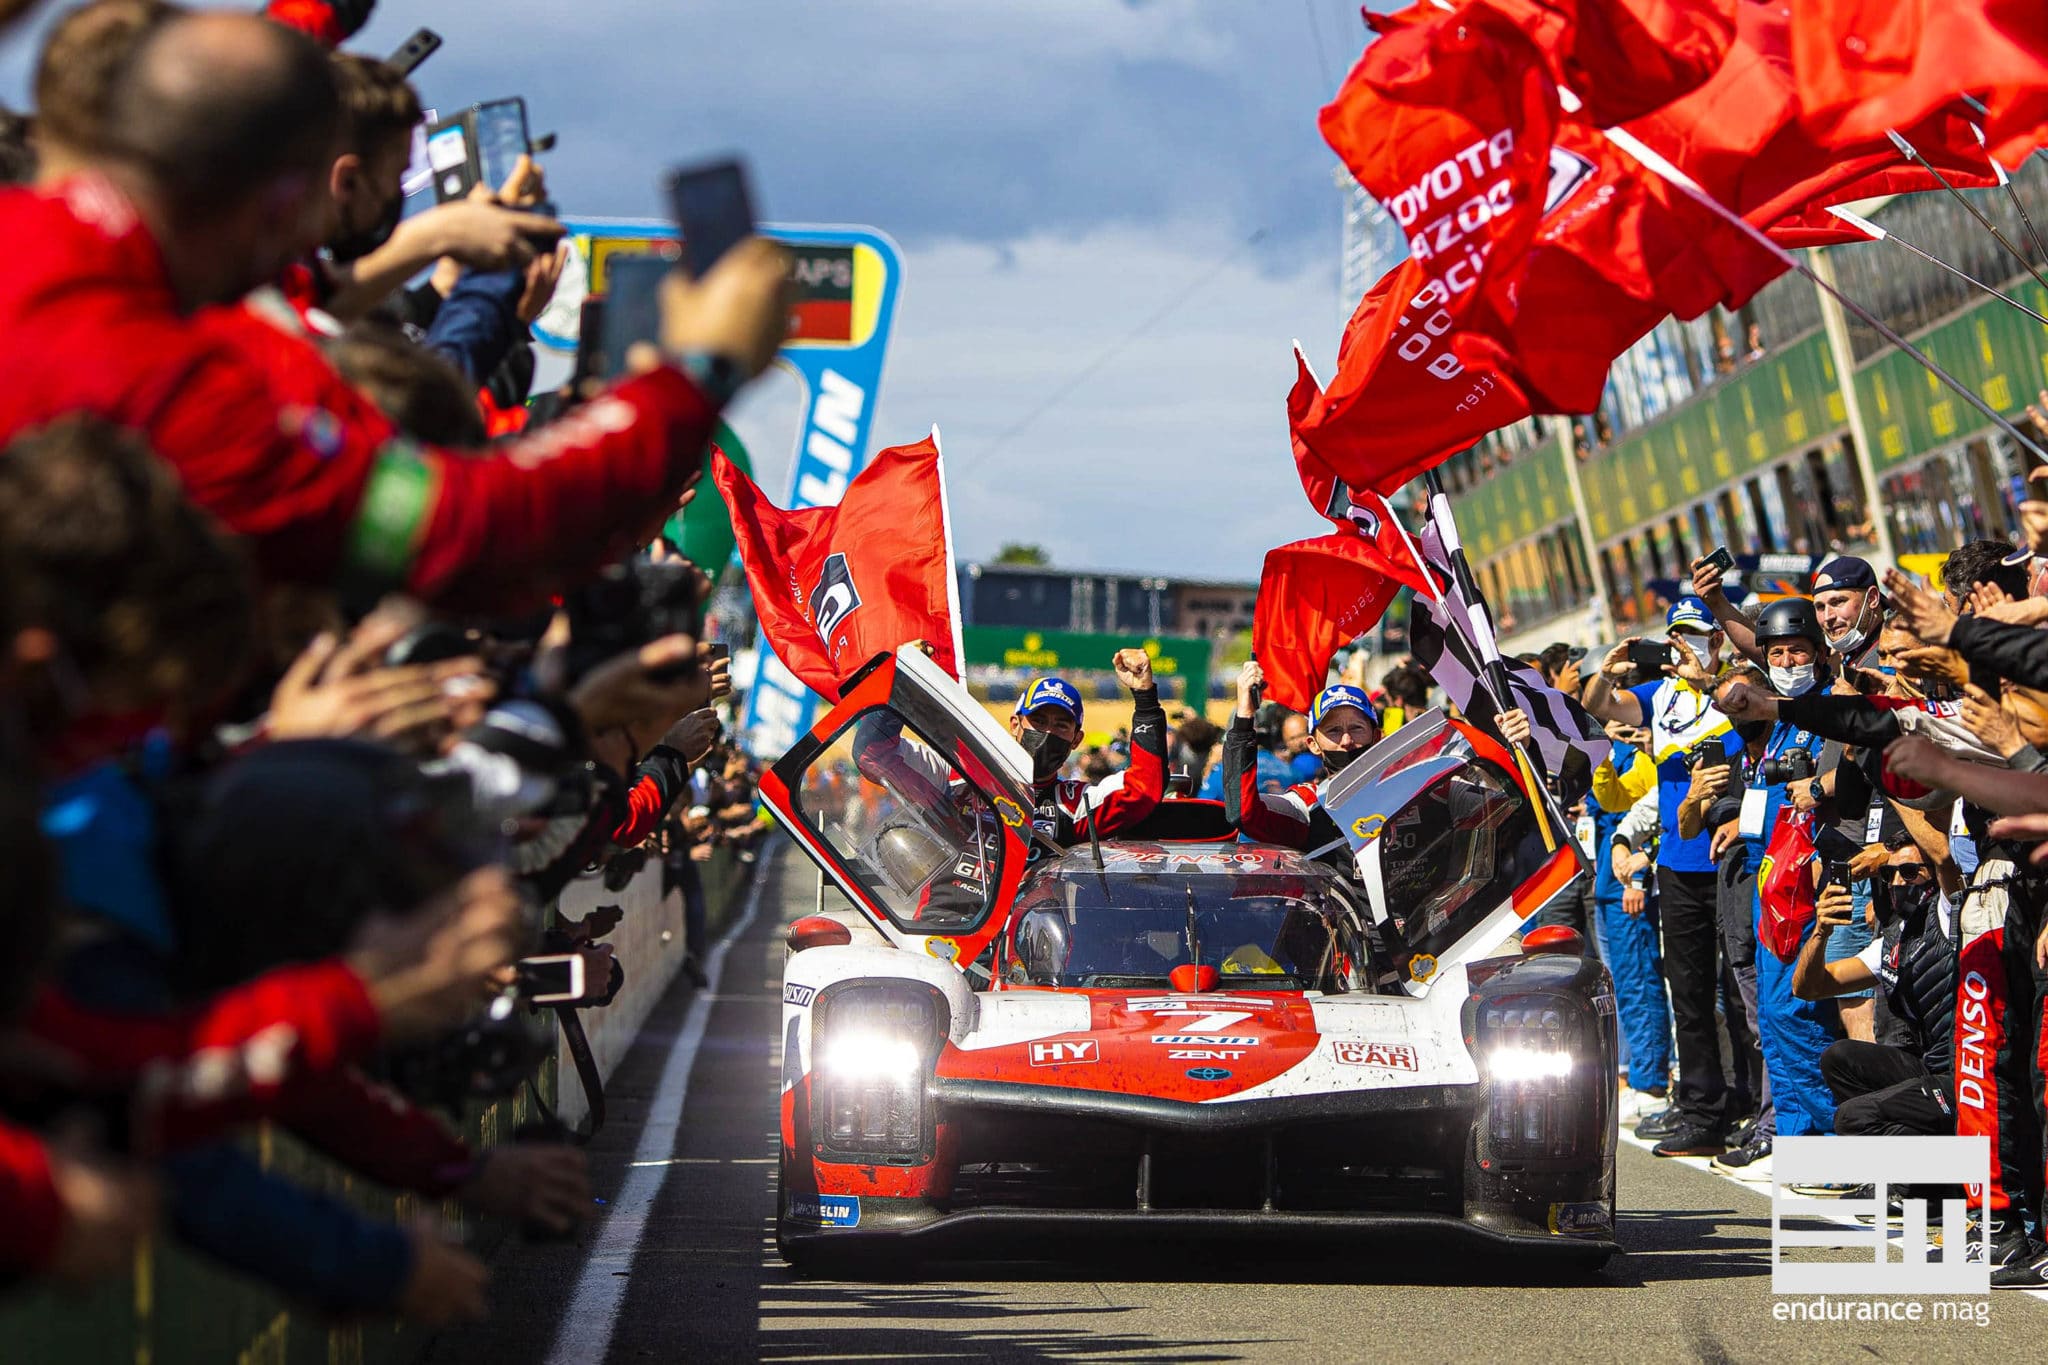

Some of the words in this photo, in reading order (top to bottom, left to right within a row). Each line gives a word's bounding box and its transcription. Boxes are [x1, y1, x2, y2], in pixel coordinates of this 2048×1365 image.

[1382, 129, 1514, 227] OYOTA
[1410, 179, 1514, 259] AZOO
[794, 257, 852, 288] APS
[952, 880, 986, 896] RACIN
[1153, 1010, 1253, 1032] 7
[1339, 1043, 1409, 1055] HYPER
[1959, 970, 1988, 1110] DENSO
[1033, 1041, 1095, 1062] HY
[1168, 1050, 1246, 1060] ZENT
[1341, 1050, 1411, 1068] CAR
